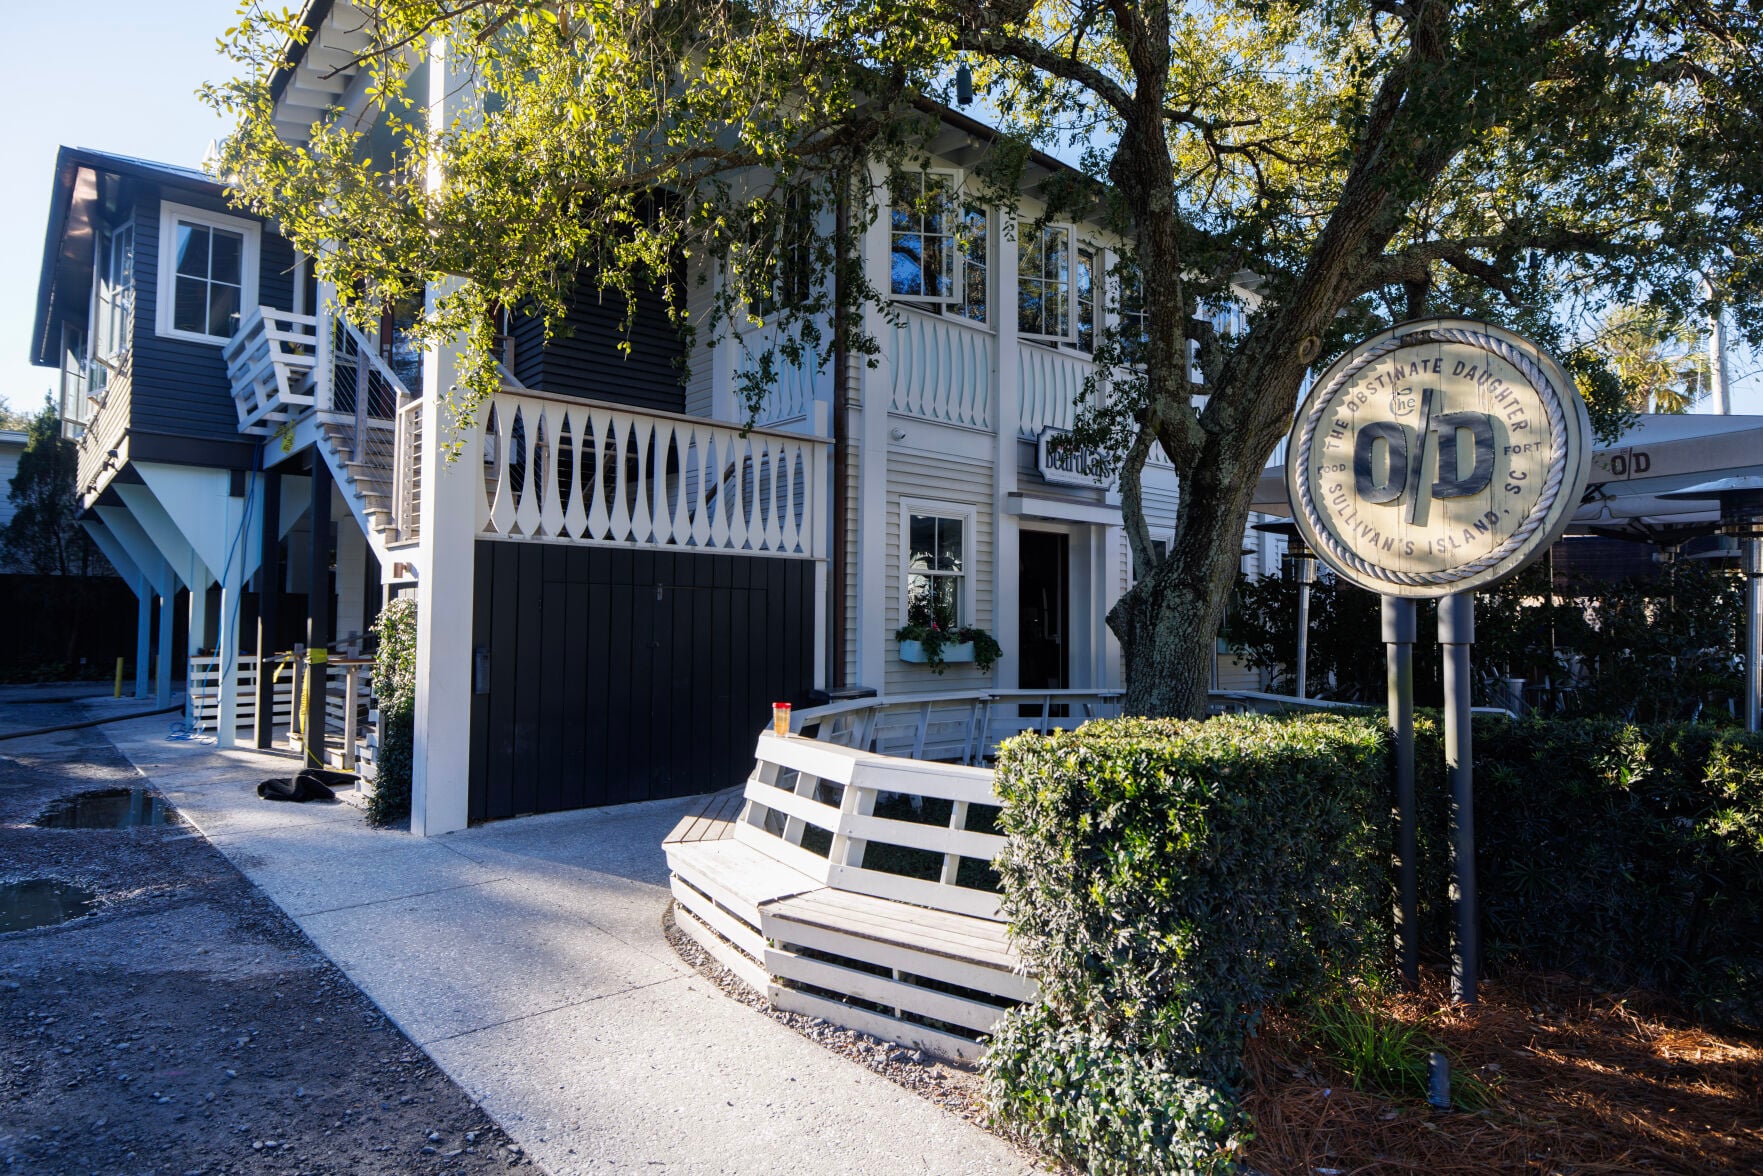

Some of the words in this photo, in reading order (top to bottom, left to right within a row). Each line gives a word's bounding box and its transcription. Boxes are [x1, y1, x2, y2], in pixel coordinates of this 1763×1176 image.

[1326, 418, 1349, 450] THE
[1346, 357, 1444, 413] OBSTINATE
[1452, 360, 1529, 433] DAUGHTER
[1317, 463, 1346, 475] FOOD
[1503, 441, 1542, 456] FORT
[1328, 483, 1415, 556] SULLIVAN'S
[1428, 509, 1510, 556] ISLAND,
[1505, 470, 1528, 495] SC
